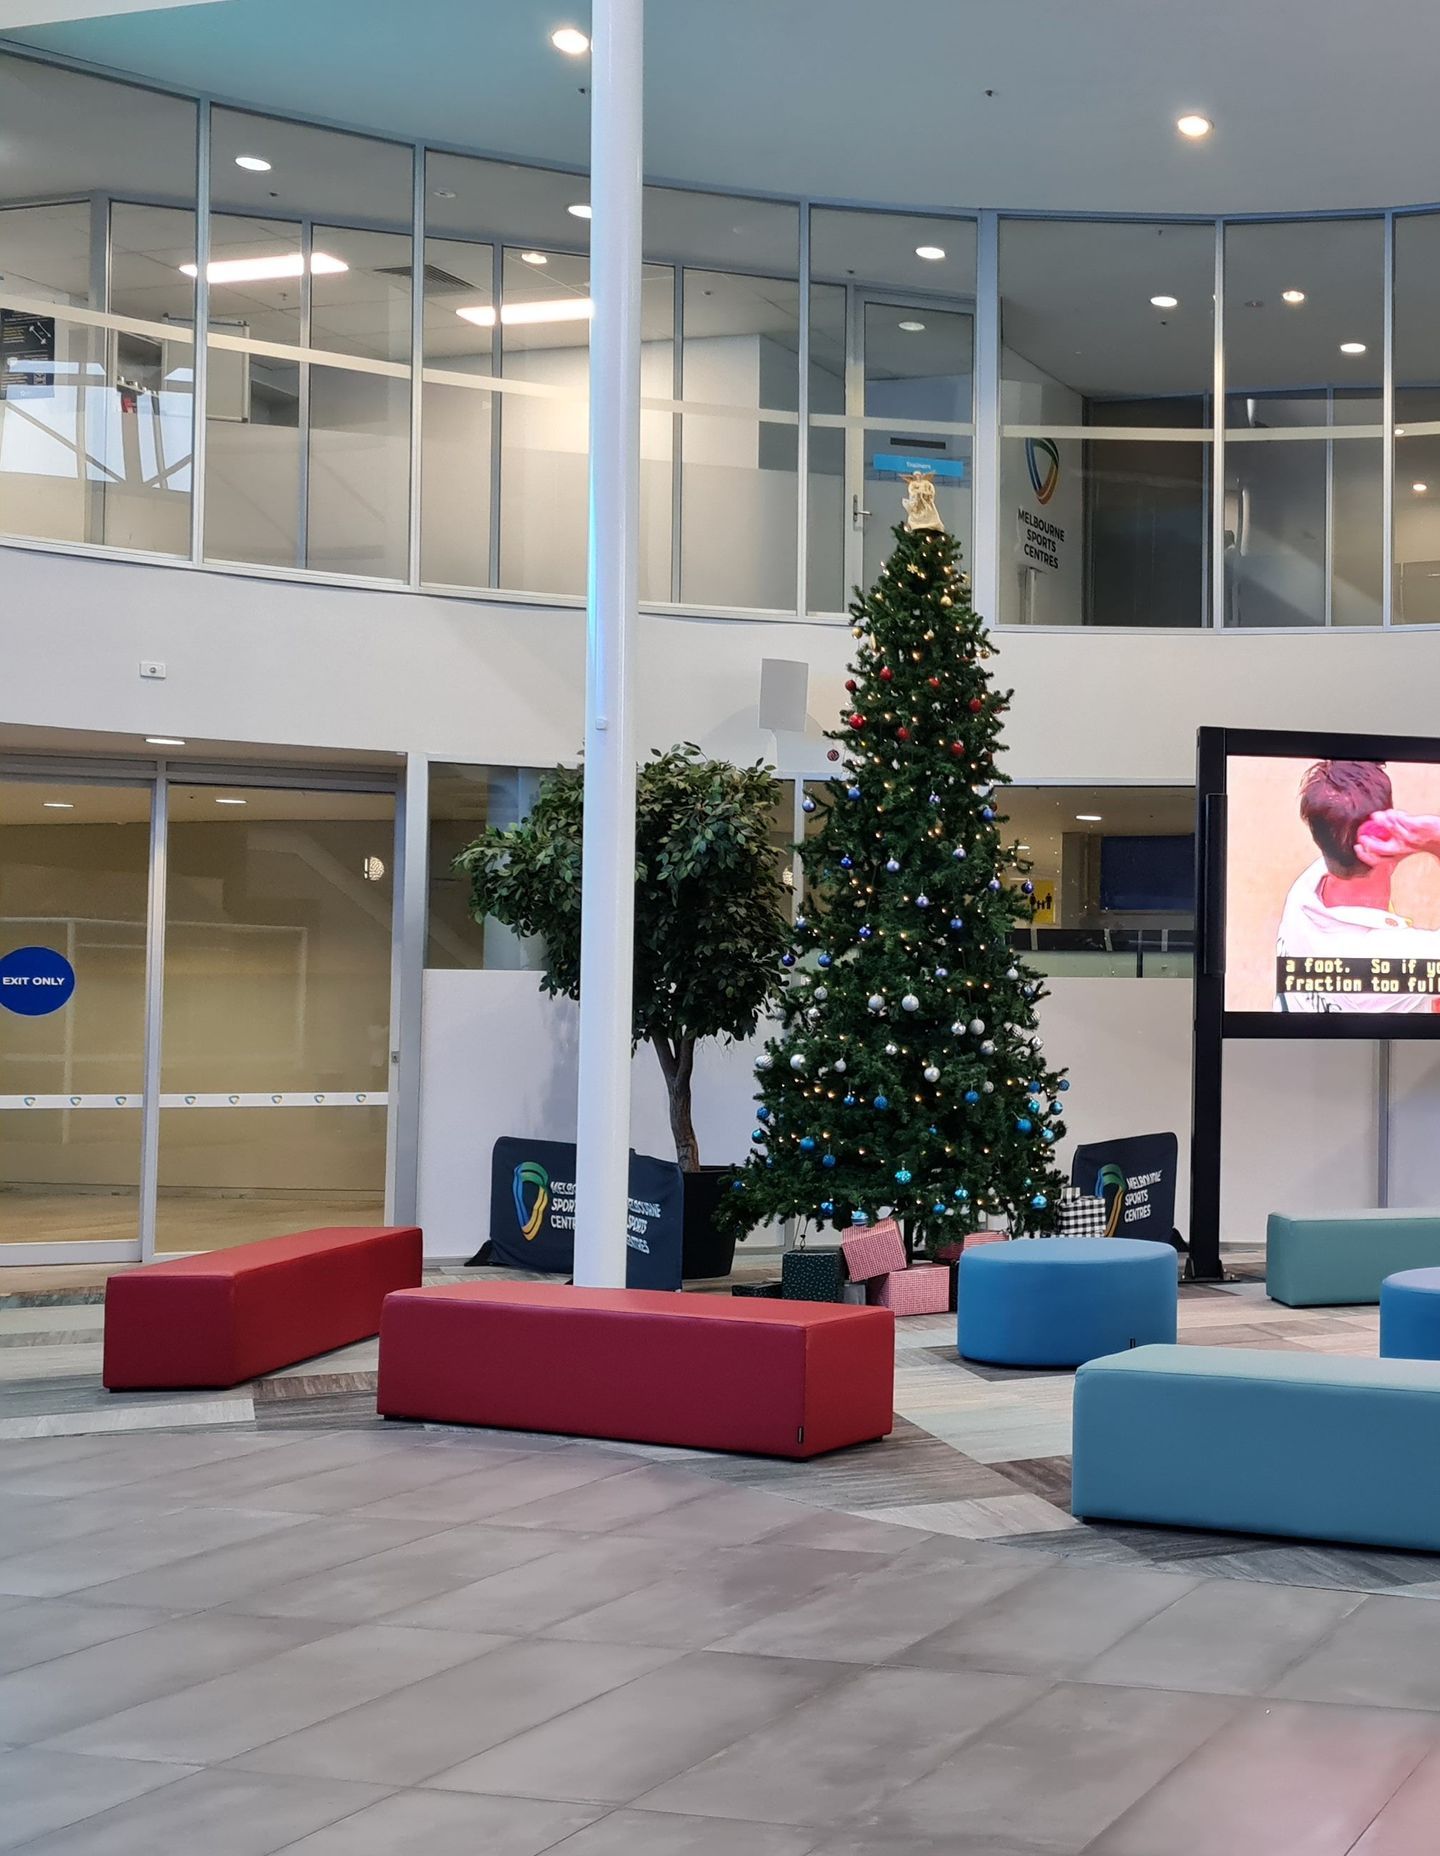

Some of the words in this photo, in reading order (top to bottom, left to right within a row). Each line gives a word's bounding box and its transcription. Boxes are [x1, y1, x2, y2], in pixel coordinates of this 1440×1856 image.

[1018, 508, 1064, 542] MELBOURNE
[1027, 529, 1056, 553] SPORTS
[1024, 544, 1058, 569] CENTRES
[1286, 960, 1296, 973] a
[1304, 958, 1351, 973] foot.
[1371, 959, 1391, 974] So
[1402, 959, 1417, 974] if
[2, 976, 30, 985] EXIT
[32, 976, 65, 986] ONLY
[1286, 976, 1362, 992] fraction
[1371, 977, 1400, 992] too
[1125, 1189, 1149, 1206] SPORTS
[1124, 1204, 1151, 1223] CENTRES
